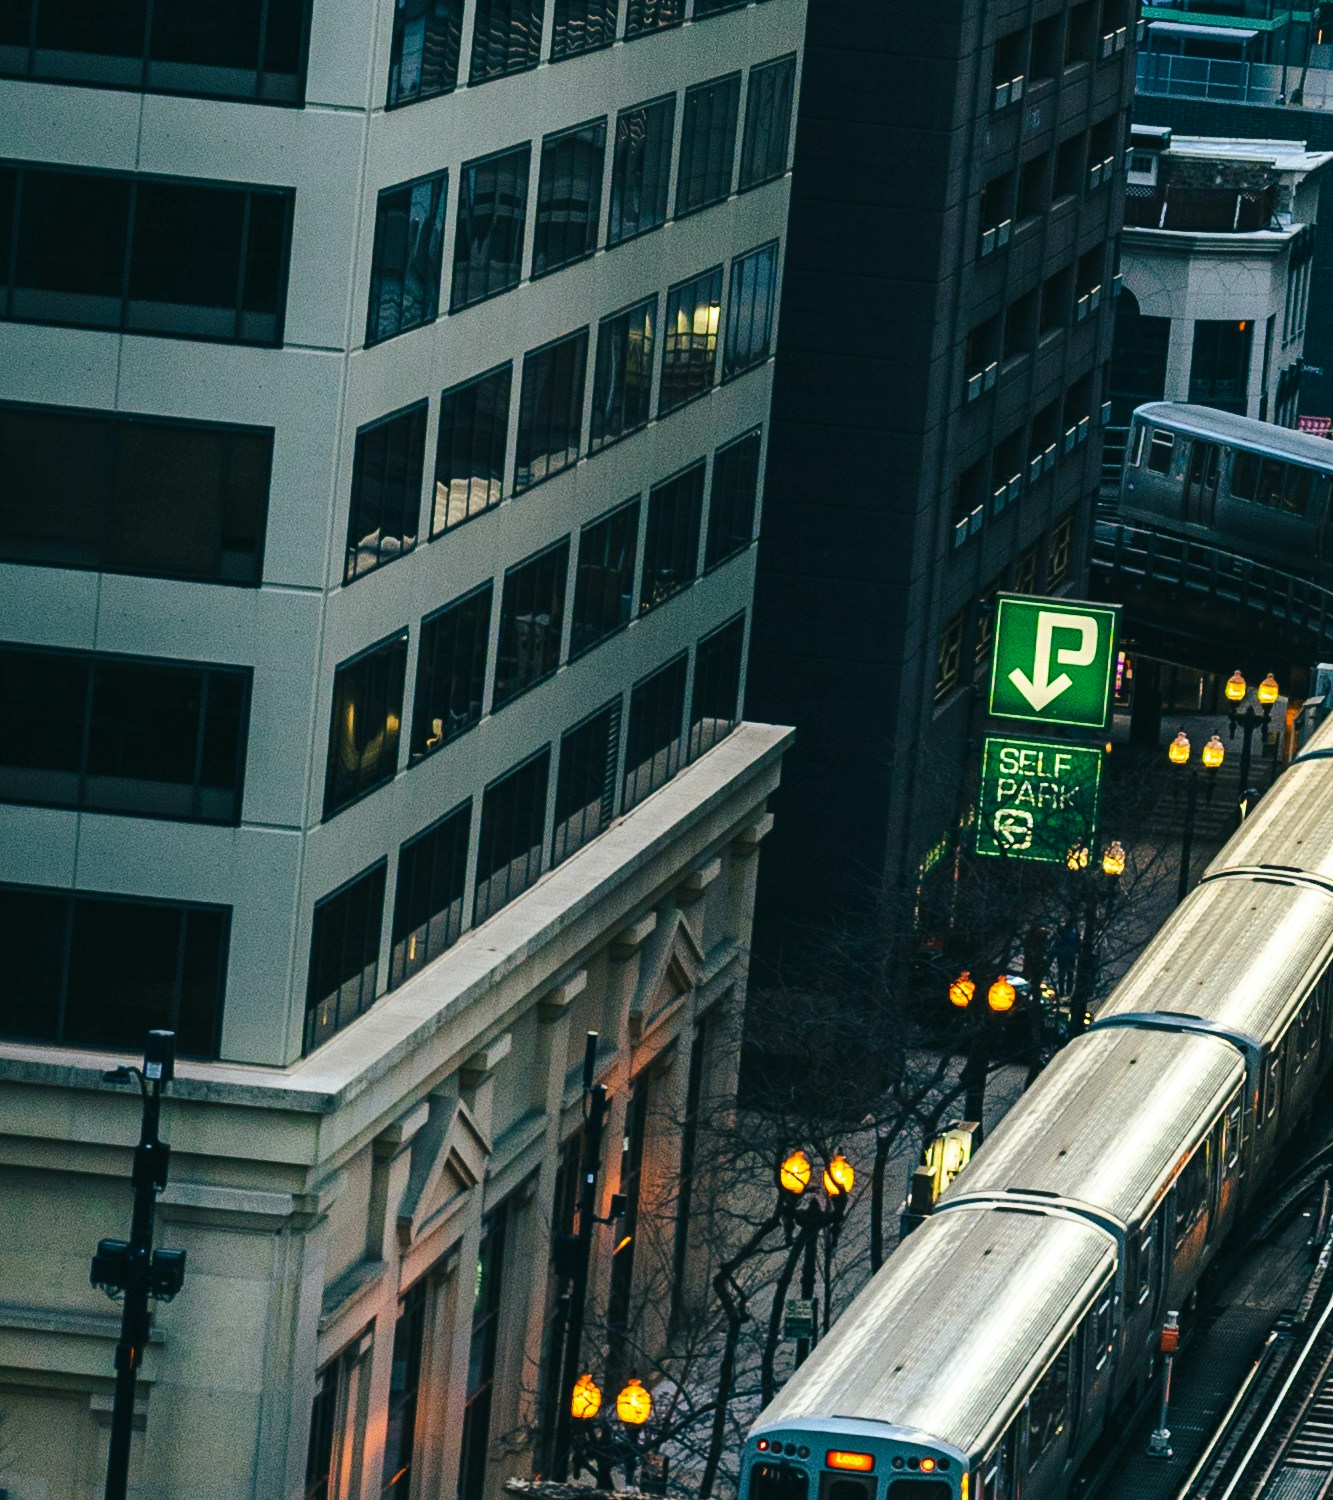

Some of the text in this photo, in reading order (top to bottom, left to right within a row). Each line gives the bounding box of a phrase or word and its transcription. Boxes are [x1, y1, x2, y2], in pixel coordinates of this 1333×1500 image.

[999, 747, 1073, 779] SELF
[997, 777, 1080, 810] PARK
[836, 1453, 864, 1467] Loop
